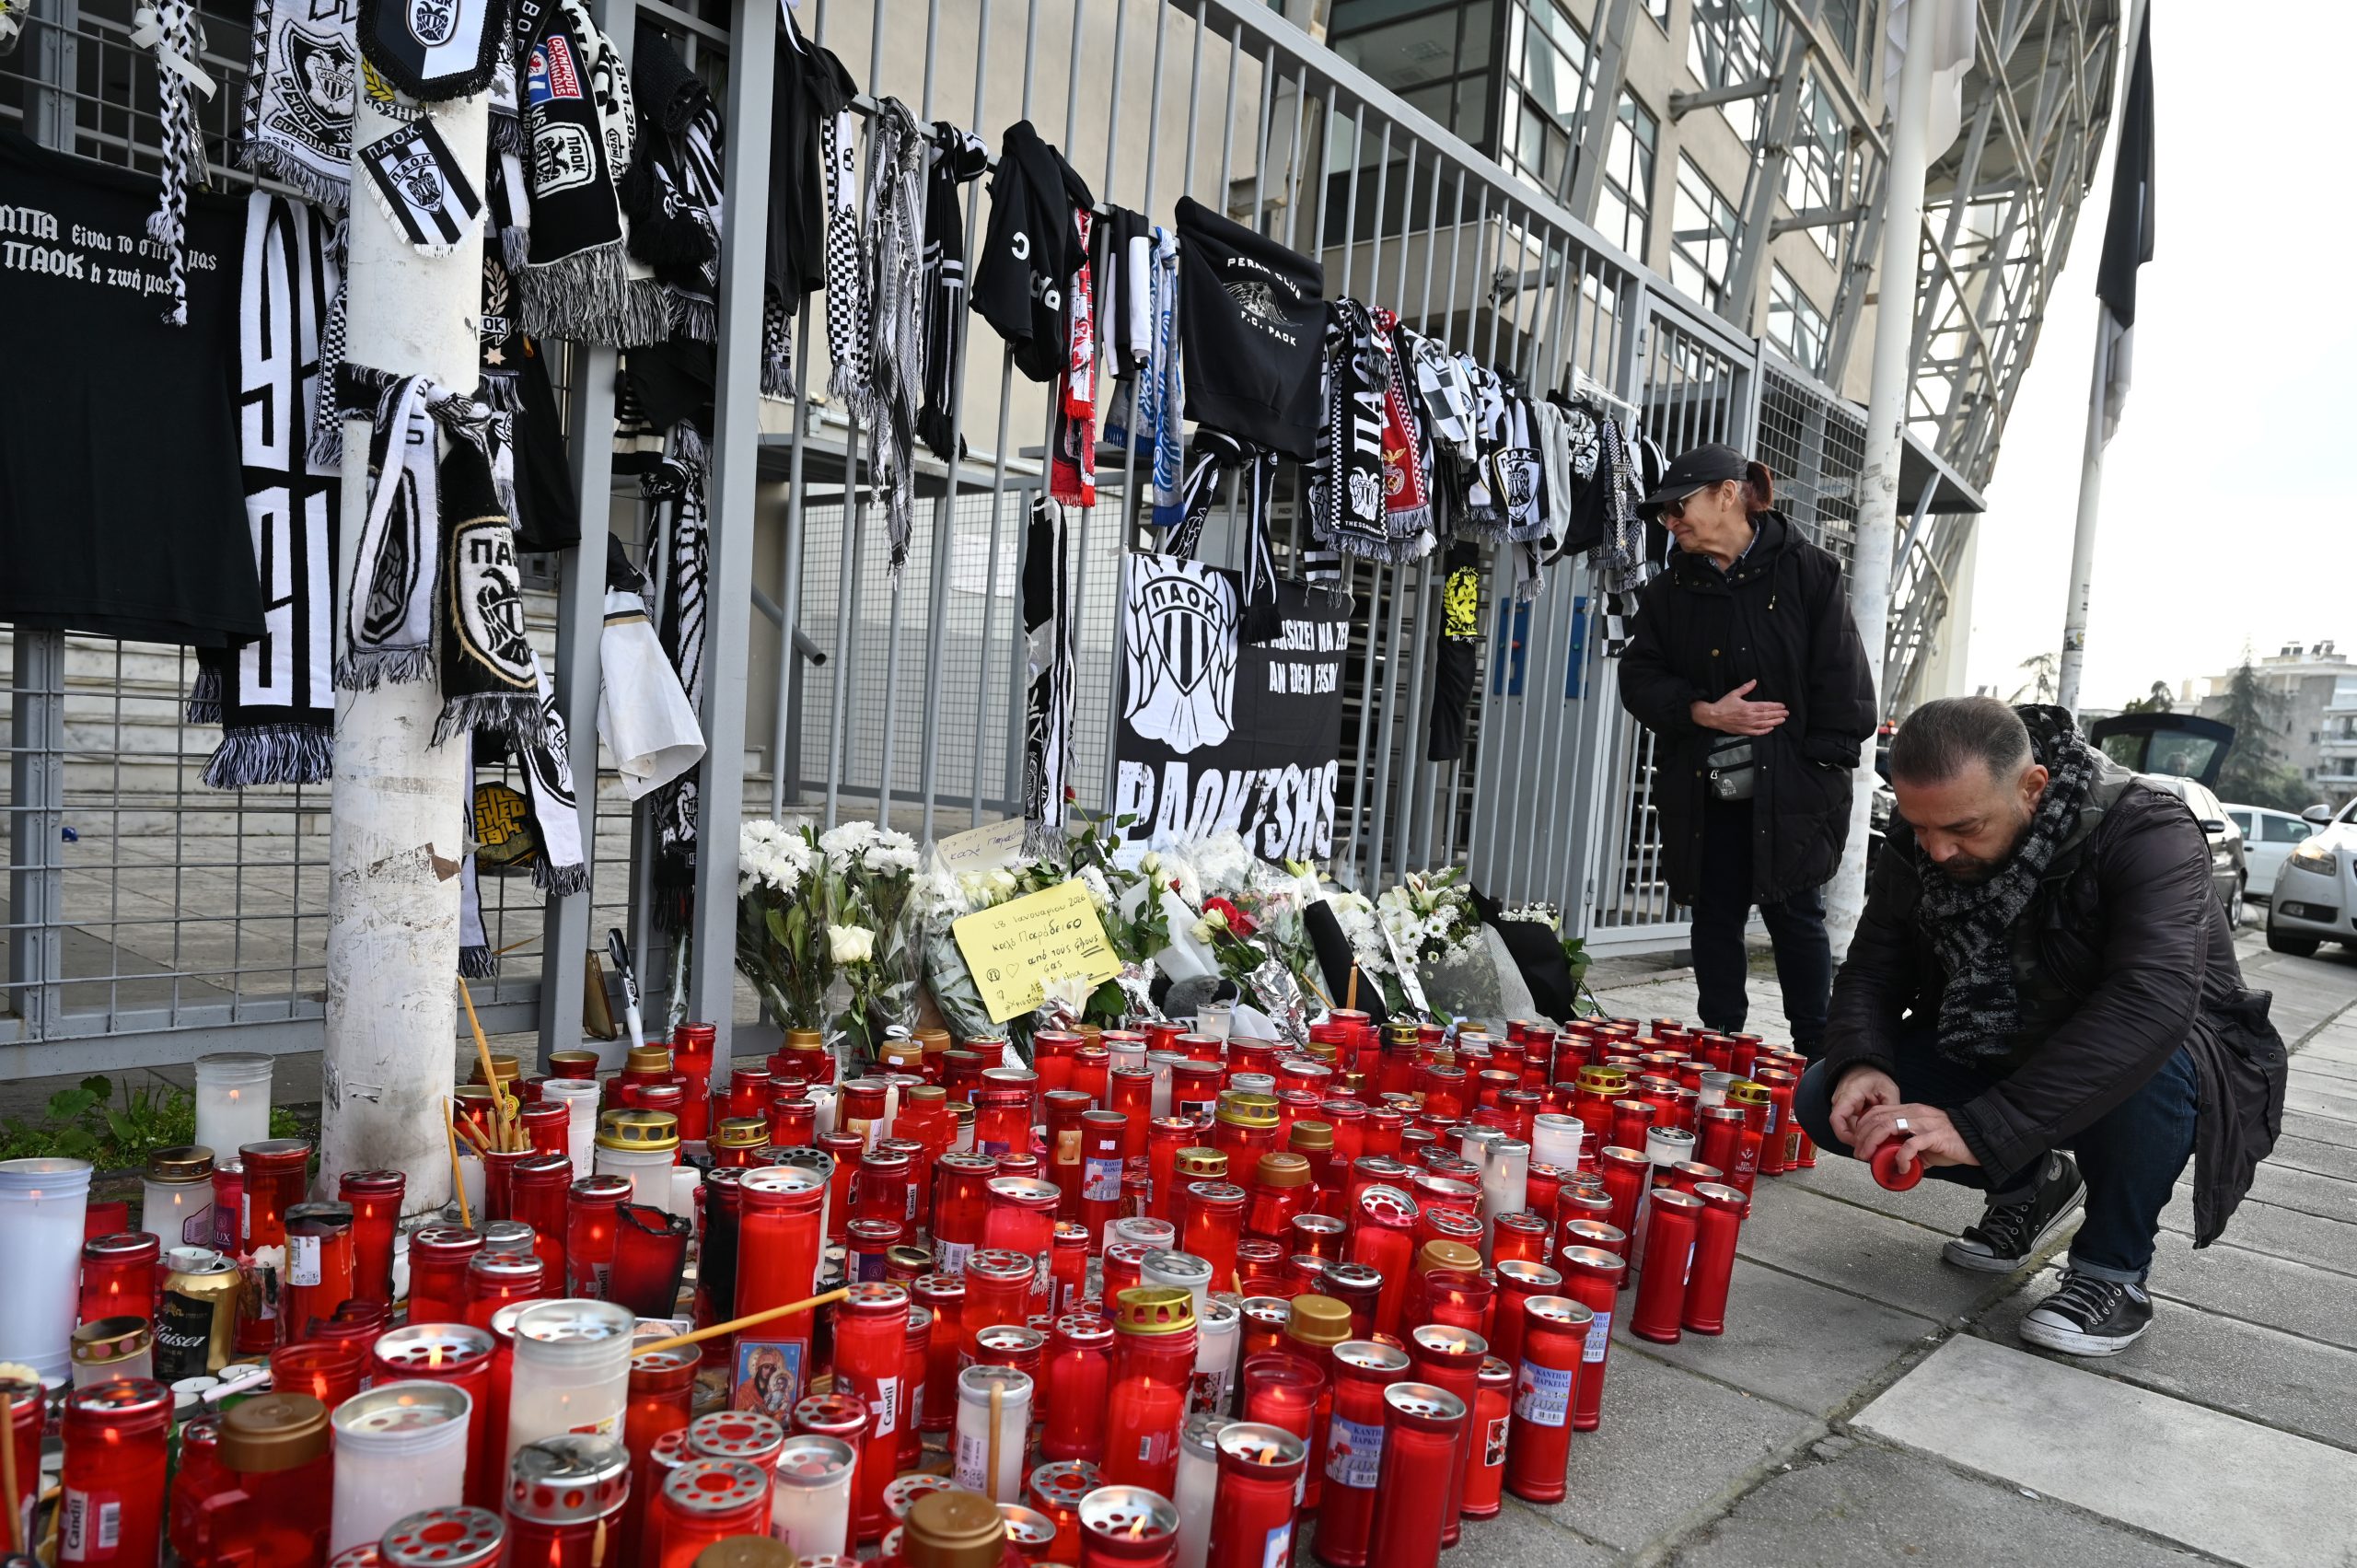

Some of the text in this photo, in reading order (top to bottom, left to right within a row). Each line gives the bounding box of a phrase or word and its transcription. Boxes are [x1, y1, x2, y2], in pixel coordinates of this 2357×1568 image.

[552, 39, 577, 95] OLYMPIQUE
[566, 135, 586, 173] ΠΑΟΚ
[2, 240, 85, 280] ΠΑΟΚ
[482, 318, 505, 332] ΟΚ
[1269, 325, 1296, 346] PAOK
[470, 539, 512, 566] ΠΑ
[1151, 583, 1217, 621] ΠΑΟΚ
[1269, 661, 1286, 693] AN
[1290, 663, 1311, 695] DEN
[1585, 1340, 1604, 1349] UXE
[883, 1385, 894, 1426] Candil
[1347, 1458, 1378, 1471] LUX
[68, 1498, 83, 1550] Candil
